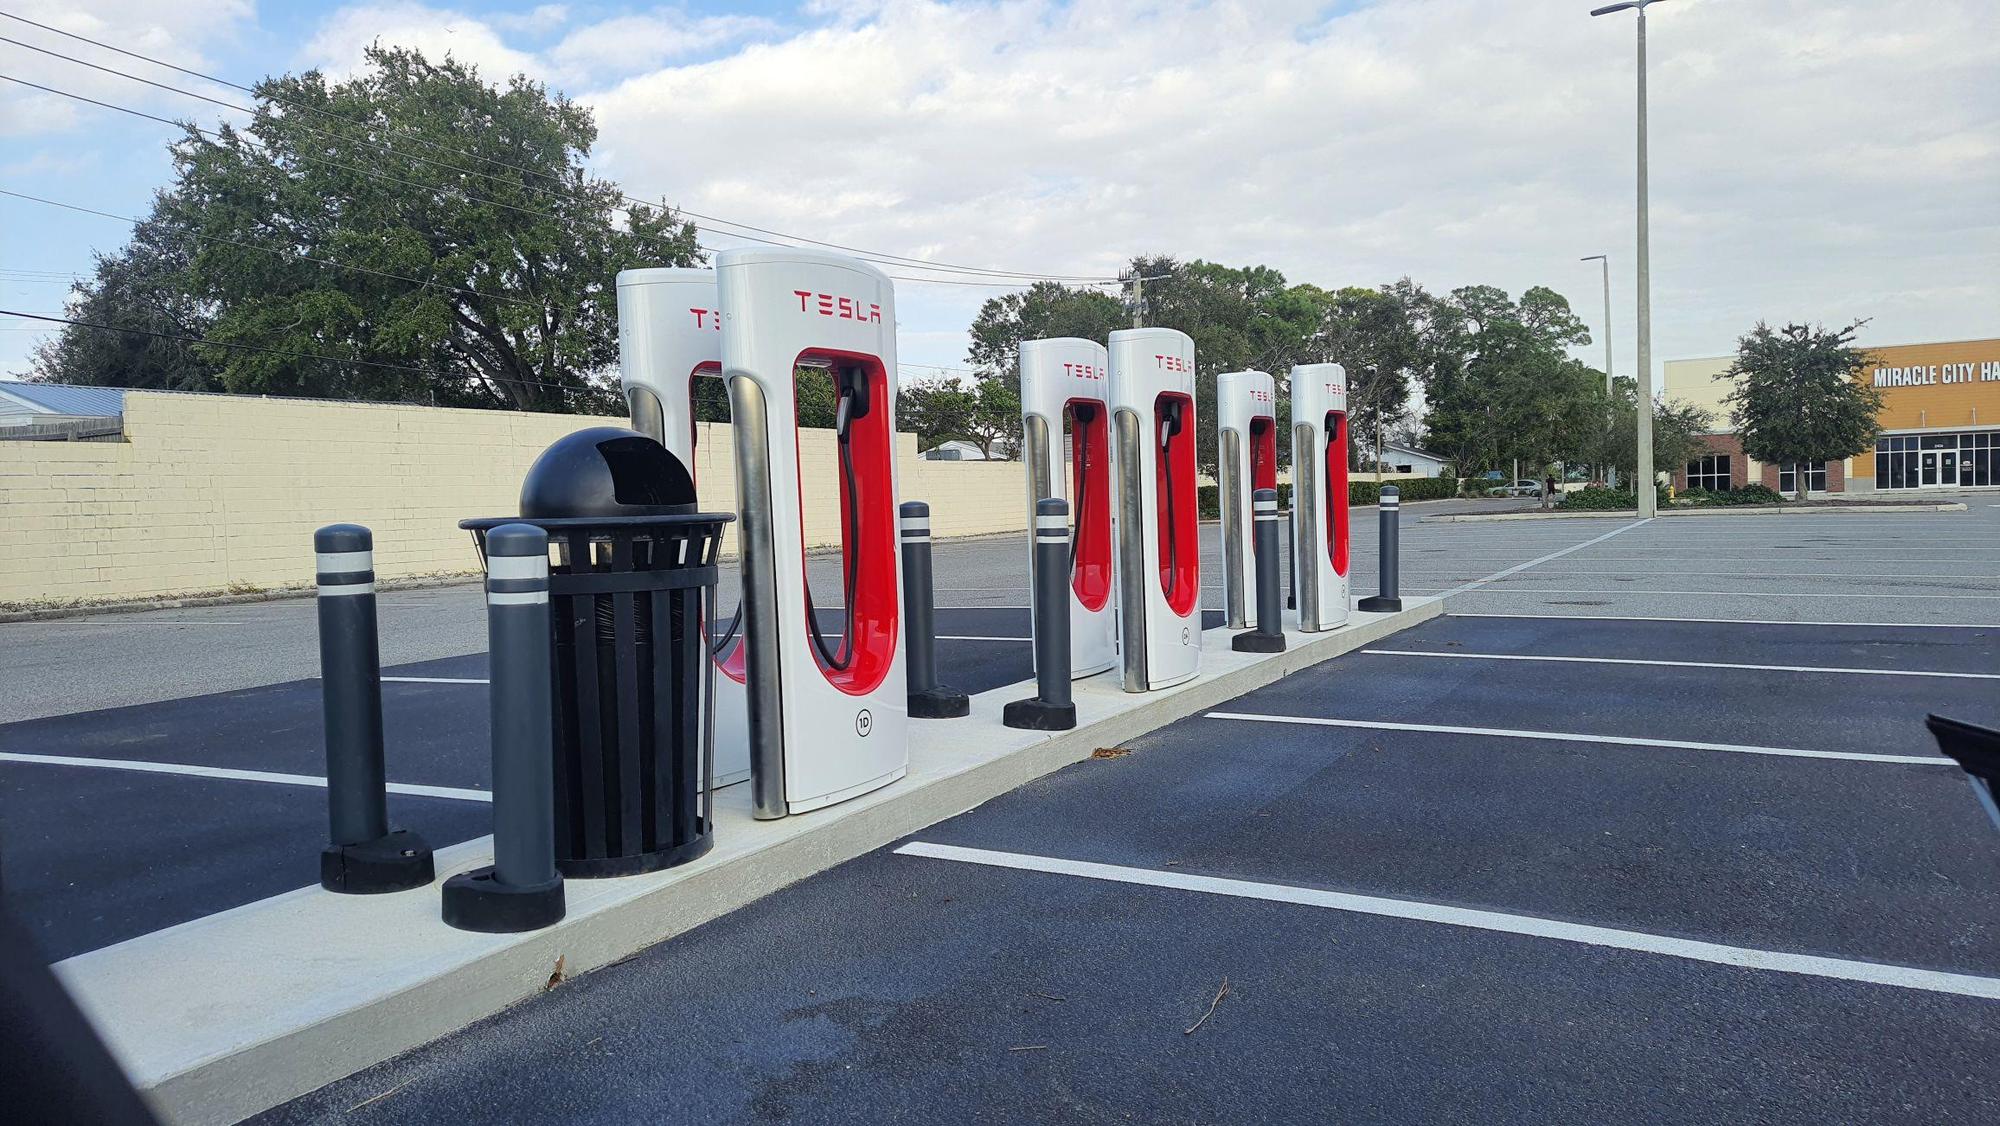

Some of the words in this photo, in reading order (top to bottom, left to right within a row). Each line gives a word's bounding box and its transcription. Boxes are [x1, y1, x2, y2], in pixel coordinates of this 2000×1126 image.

[793, 290, 881, 325] TESLA
[1063, 363, 1105, 381] TESLA
[1155, 355, 1191, 373] TESLA
[1874, 365, 1936, 387] MIRACLE
[1942, 363, 1975, 384] CITY
[859, 717, 869, 729] 1D
